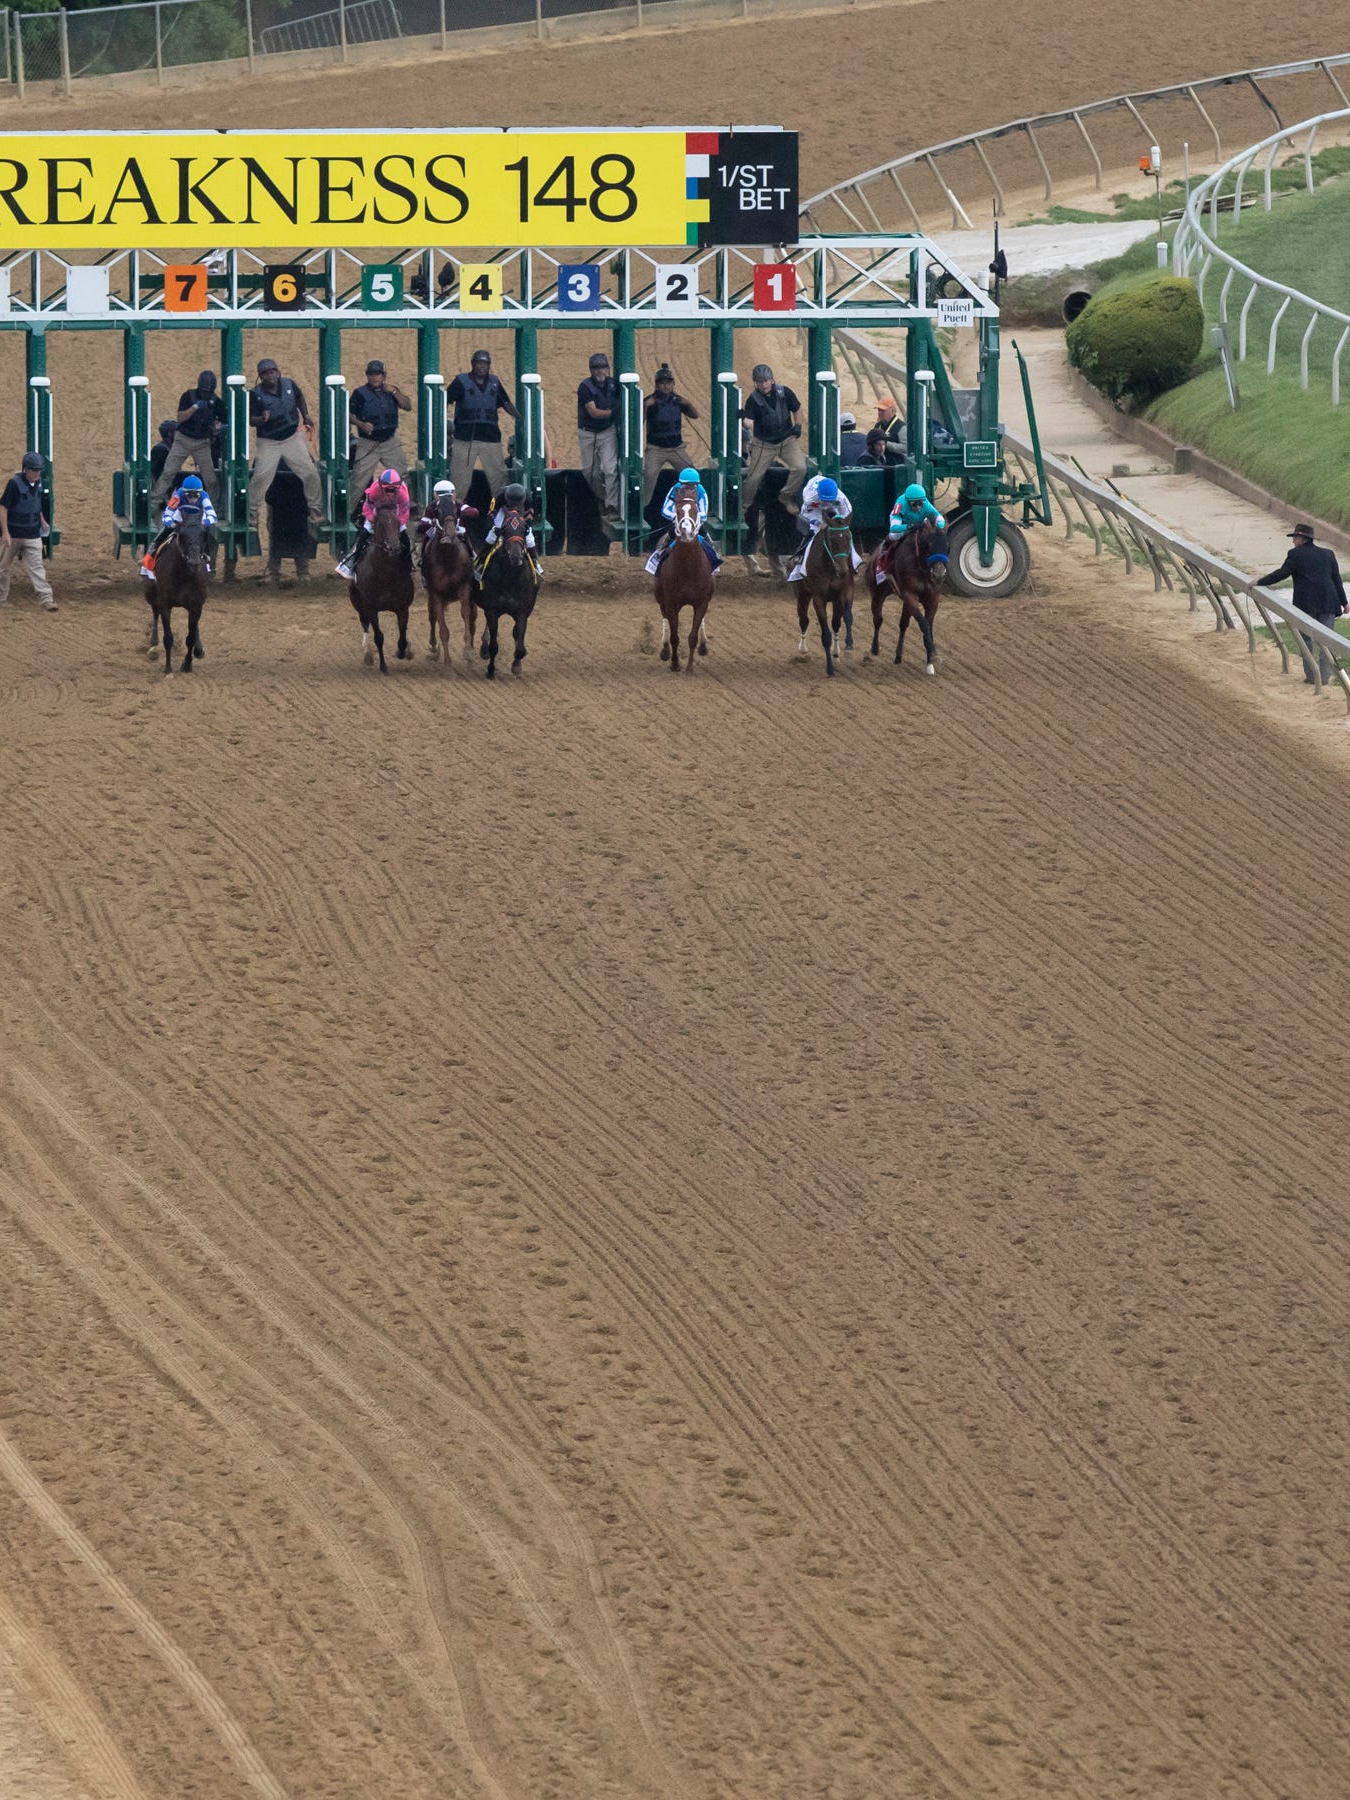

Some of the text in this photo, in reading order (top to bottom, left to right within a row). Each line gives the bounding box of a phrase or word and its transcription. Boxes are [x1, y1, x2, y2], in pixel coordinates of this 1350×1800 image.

[505, 153, 638, 223] 148
[717, 164, 774, 188] 1/ST
[739, 188, 791, 211] BET
[175, 274, 197, 302] 7
[272, 273, 297, 302] 6
[370, 273, 395, 302] 5
[469, 274, 493, 301] 4
[567, 273, 591, 302] 3
[666, 273, 689, 301] 2
[767, 273, 783, 301] 1
[940, 303, 971, 312] United
[944, 314, 967, 323] Puett
